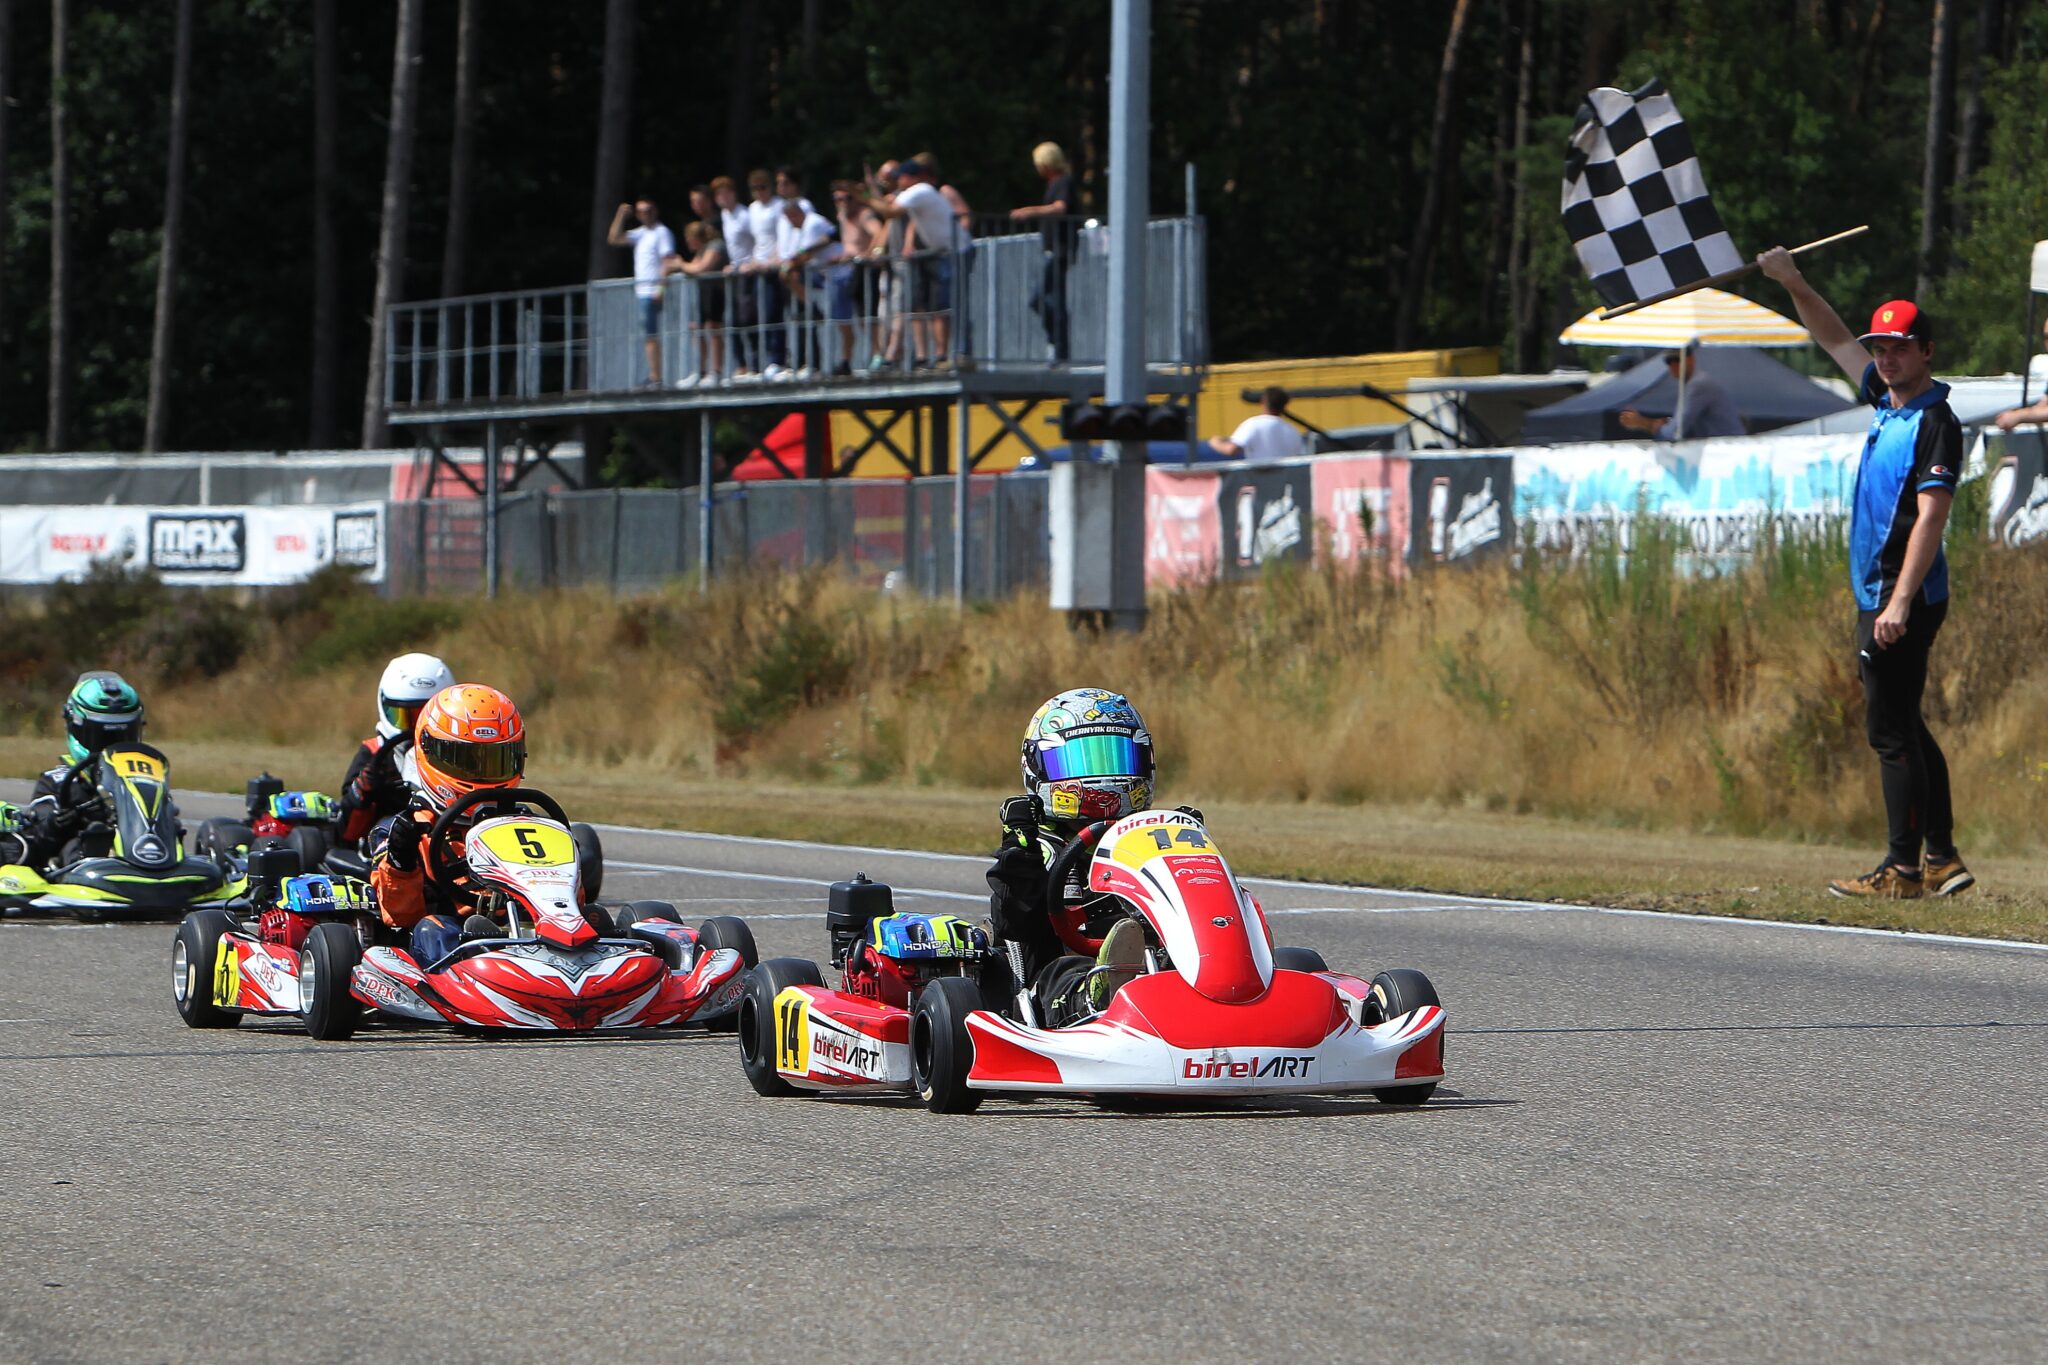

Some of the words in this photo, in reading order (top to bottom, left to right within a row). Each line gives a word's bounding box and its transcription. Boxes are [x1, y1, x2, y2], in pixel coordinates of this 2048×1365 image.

[153, 519, 239, 552] MAX
[475, 728, 495, 736] BELL
[1106, 725, 1132, 735] DESIGN
[126, 759, 154, 775] 18
[514, 828, 546, 859] 5
[1147, 828, 1208, 850] 14
[304, 895, 349, 905] HONDA
[903, 941, 951, 951] HONDA
[937, 948, 984, 958] CADET
[367, 979, 397, 999] DFK
[781, 999, 804, 1069] 14
[813, 1032, 880, 1072] birelART
[1183, 1056, 1316, 1079] birelART
